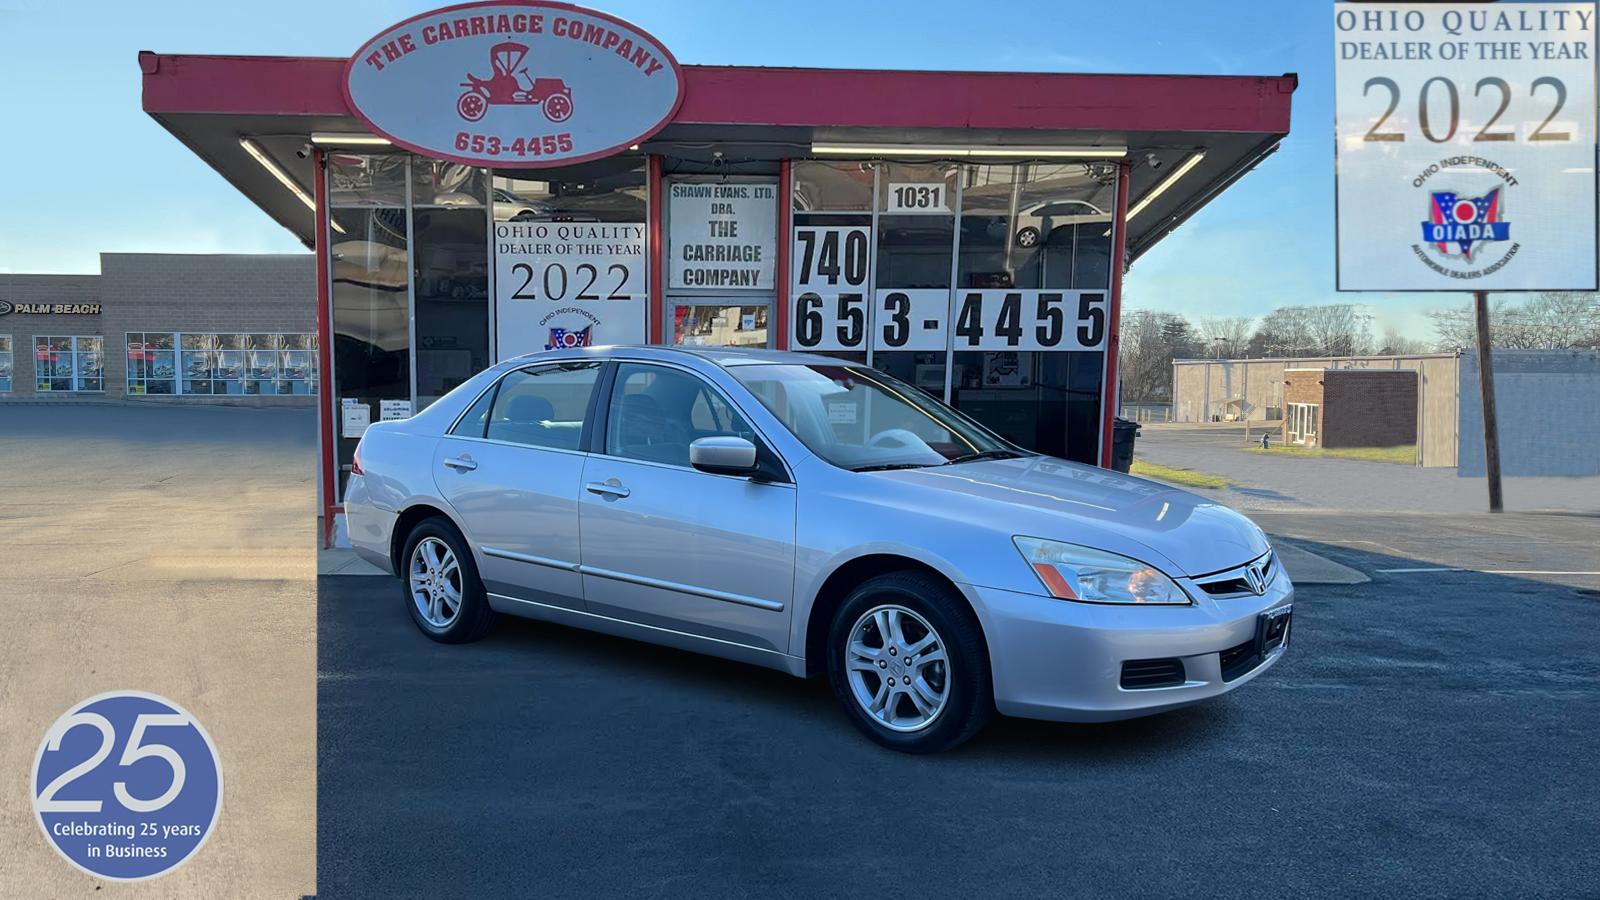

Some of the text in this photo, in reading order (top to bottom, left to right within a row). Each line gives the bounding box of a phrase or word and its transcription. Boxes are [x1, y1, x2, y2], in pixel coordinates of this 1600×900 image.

[1336, 10, 1592, 35] OHIO QUALITY
[366, 14, 664, 77] THE CARRIAGE COMPANY
[1340, 41, 1589, 60] DEALER OF THE YEAR
[1363, 76, 1571, 143] 2022
[454, 131, 573, 156] 653-4455
[1412, 155, 1519, 188] OHIO INDEPENDENT
[672, 186, 712, 199] SHAWN
[753, 187, 775, 199] LTD.
[894, 186, 940, 208] 1031
[711, 203, 736, 215] DBA.
[496, 225, 644, 241] OHIO QUALITY
[708, 220, 738, 238] THE
[1432, 224, 1495, 240] OIADA
[499, 243, 642, 255] DEALER OF THE YEAR
[682, 245, 762, 262] CARRIAGE
[797, 230, 868, 286] 740
[1411, 242, 1520, 279] AUTOMOBILE DEALERS ASSOCIATION
[511, 263, 632, 301] 2022
[683, 268, 761, 286] COMPANY
[14, 303, 100, 314] PALM BEACH
[555, 307, 601, 326] INDEPENDENT
